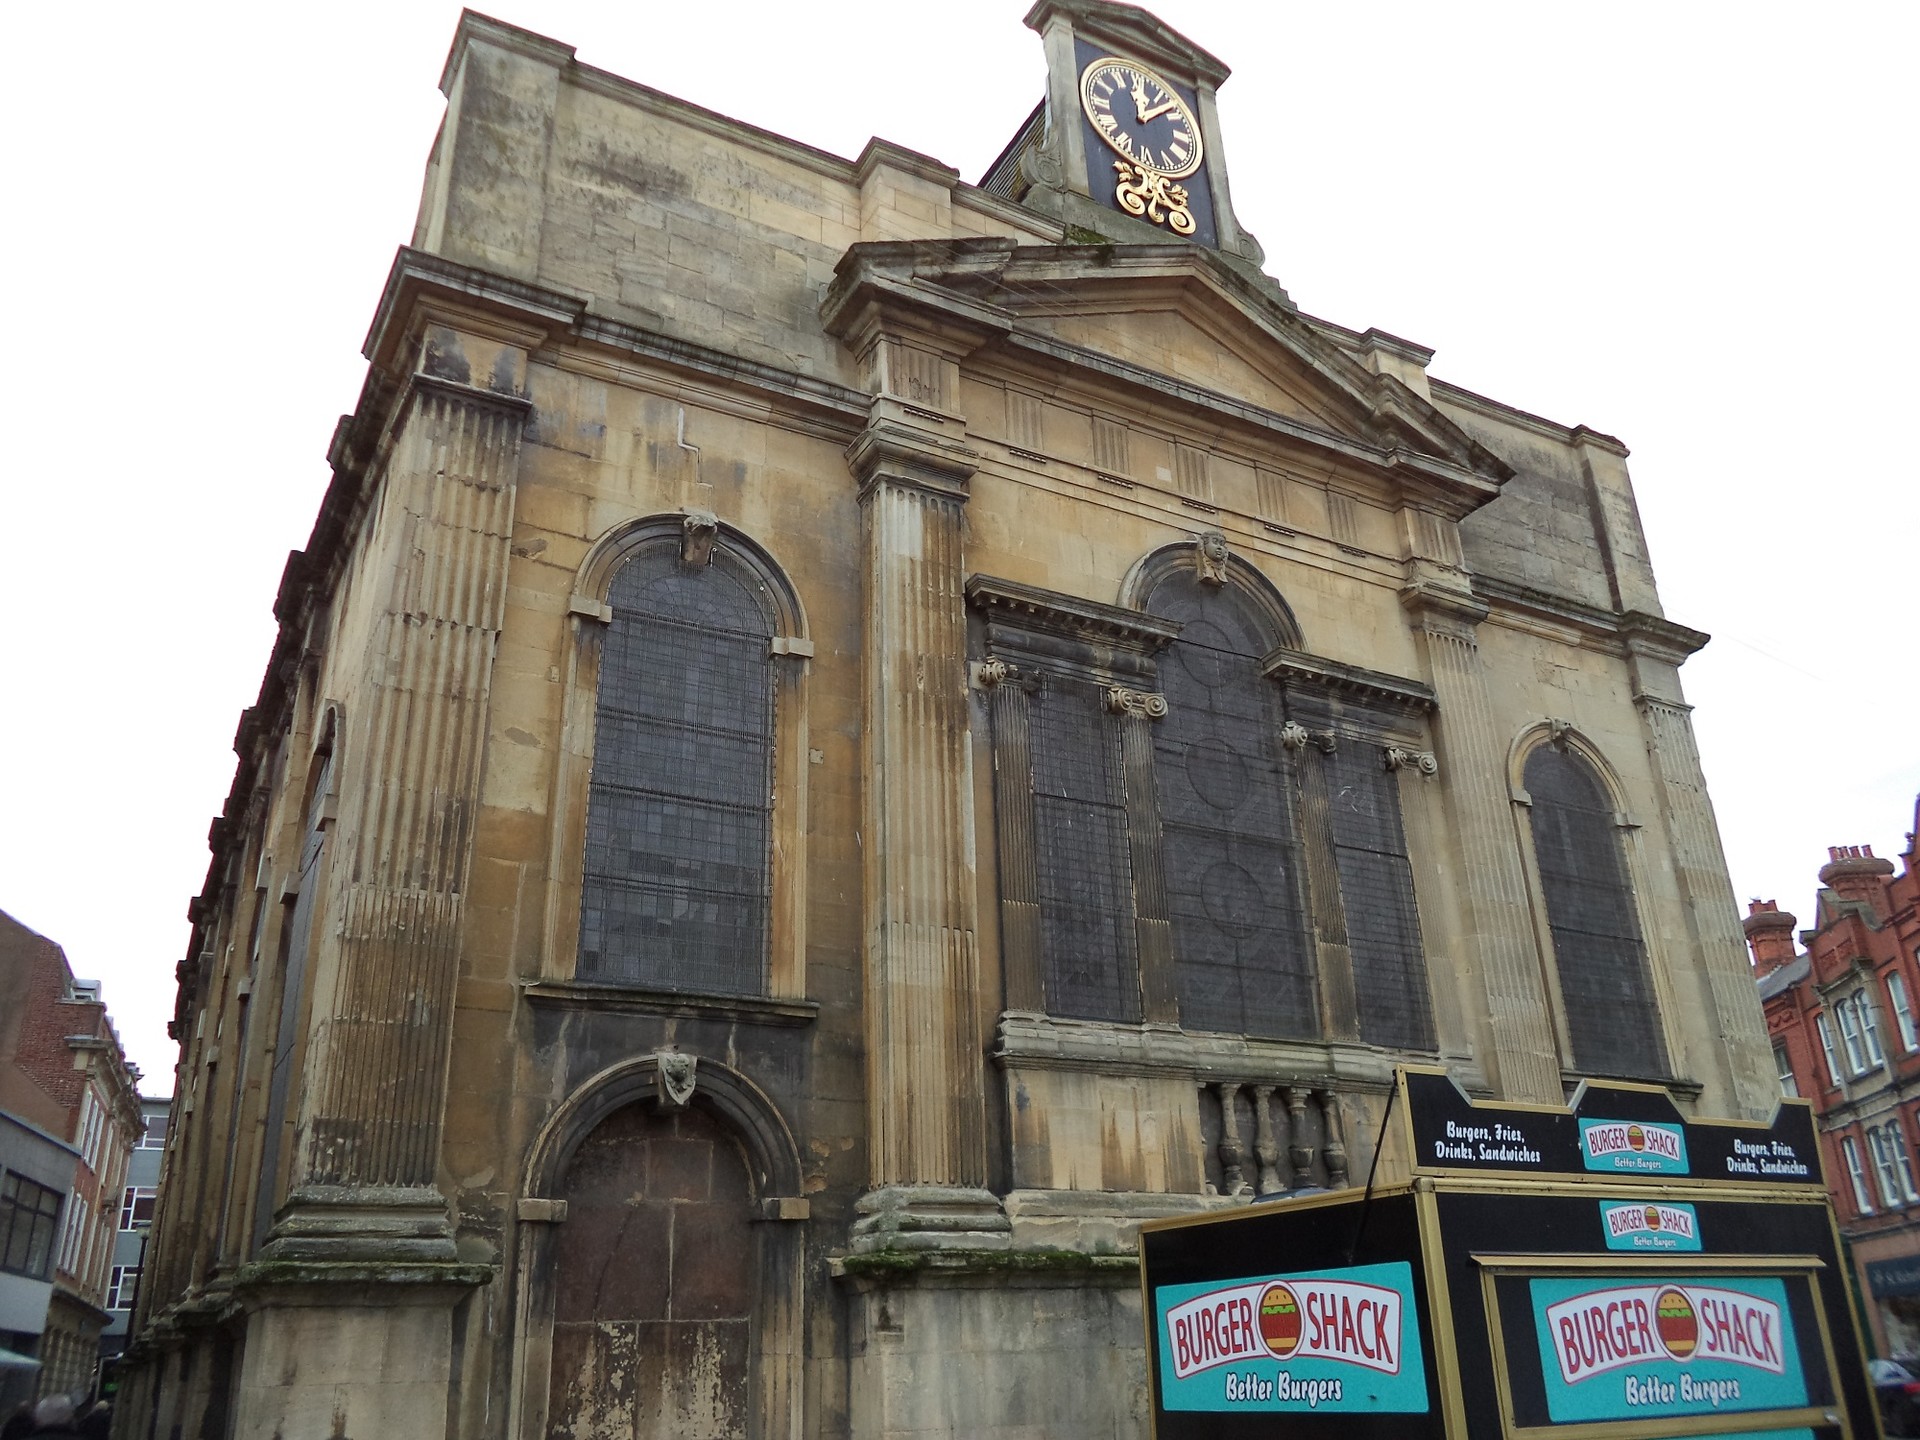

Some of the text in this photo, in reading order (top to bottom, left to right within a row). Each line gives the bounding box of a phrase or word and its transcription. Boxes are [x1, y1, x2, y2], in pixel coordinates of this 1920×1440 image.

[1446, 1120, 1525, 1143] Burgers, Fries,
[1589, 1128, 1678, 1157] BURGER SHACK
[1434, 1140, 1541, 1163] Drinks, Sandwiches
[1734, 1138, 1795, 1158] Burgers, Fries,
[1614, 1156, 1661, 1170] Better Burgers
[1726, 1156, 1807, 1175] Drinks, Sandwiches
[1610, 1209, 1691, 1236] BURGER SHACK
[1633, 1236, 1676, 1248] Better Burgers
[1175, 1292, 1393, 1371] BURGER SHACK
[1559, 1298, 1779, 1374] BURGER SHACK
[1225, 1370, 1342, 1408] Better Burgers
[1625, 1372, 1741, 1408] Better Burgers
